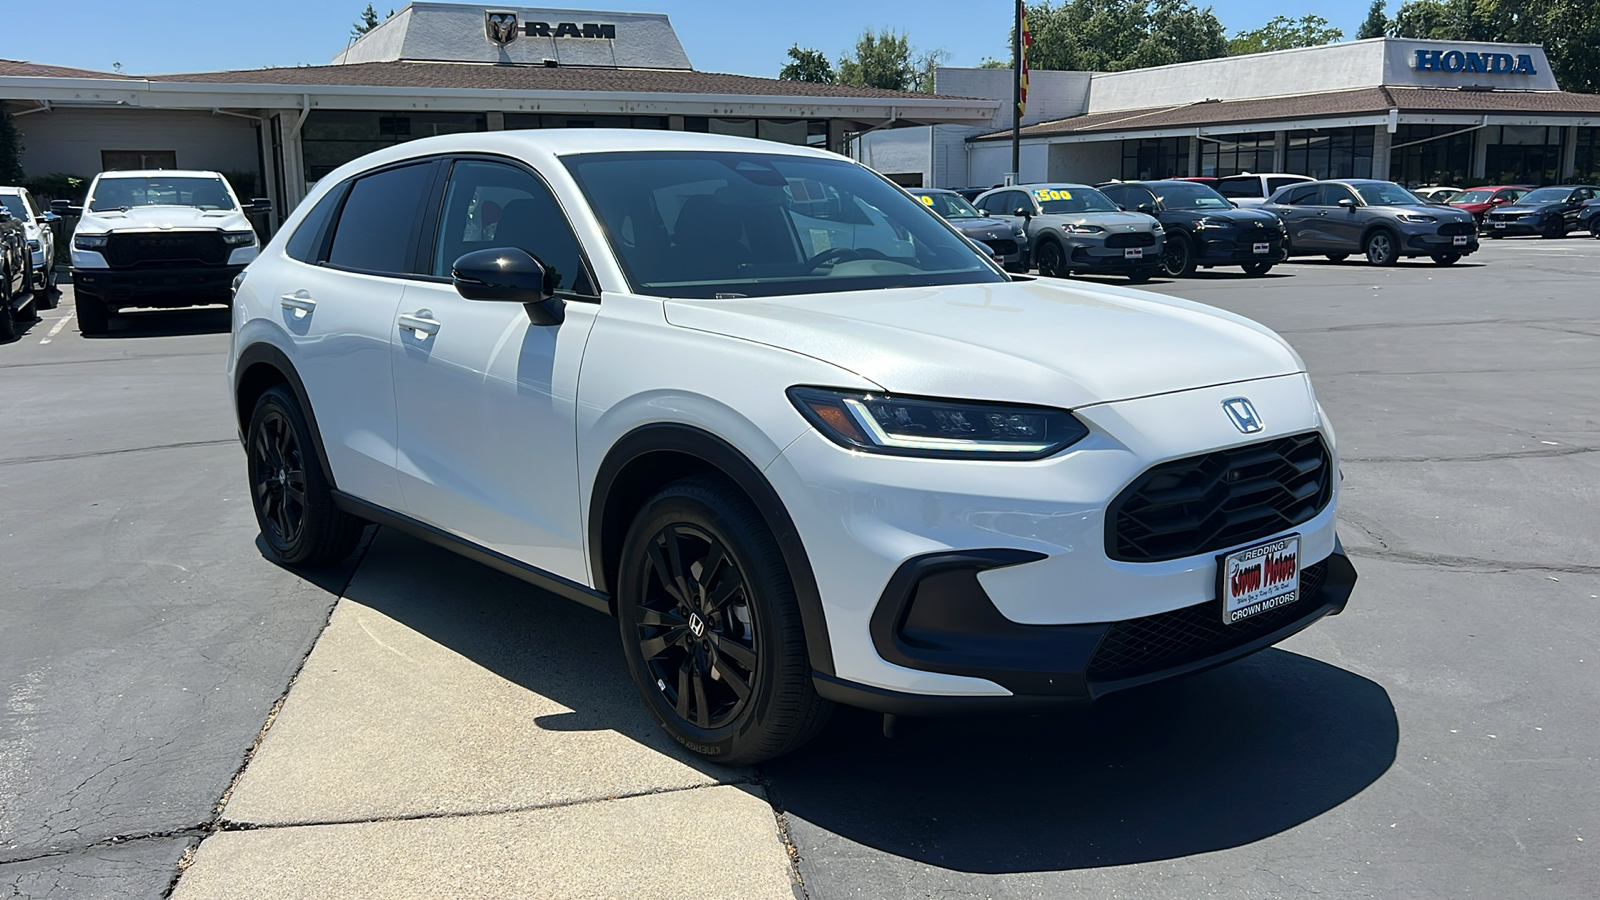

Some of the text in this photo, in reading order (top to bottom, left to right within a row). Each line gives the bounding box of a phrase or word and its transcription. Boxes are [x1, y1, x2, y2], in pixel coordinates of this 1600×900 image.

[525, 21, 616, 39] RAM
[1414, 49, 1537, 76] HONDA
[1245, 541, 1285, 560] REDDING
[1231, 552, 1296, 598] Crown Motors
[1231, 592, 1295, 621] CROWN MOTORS
